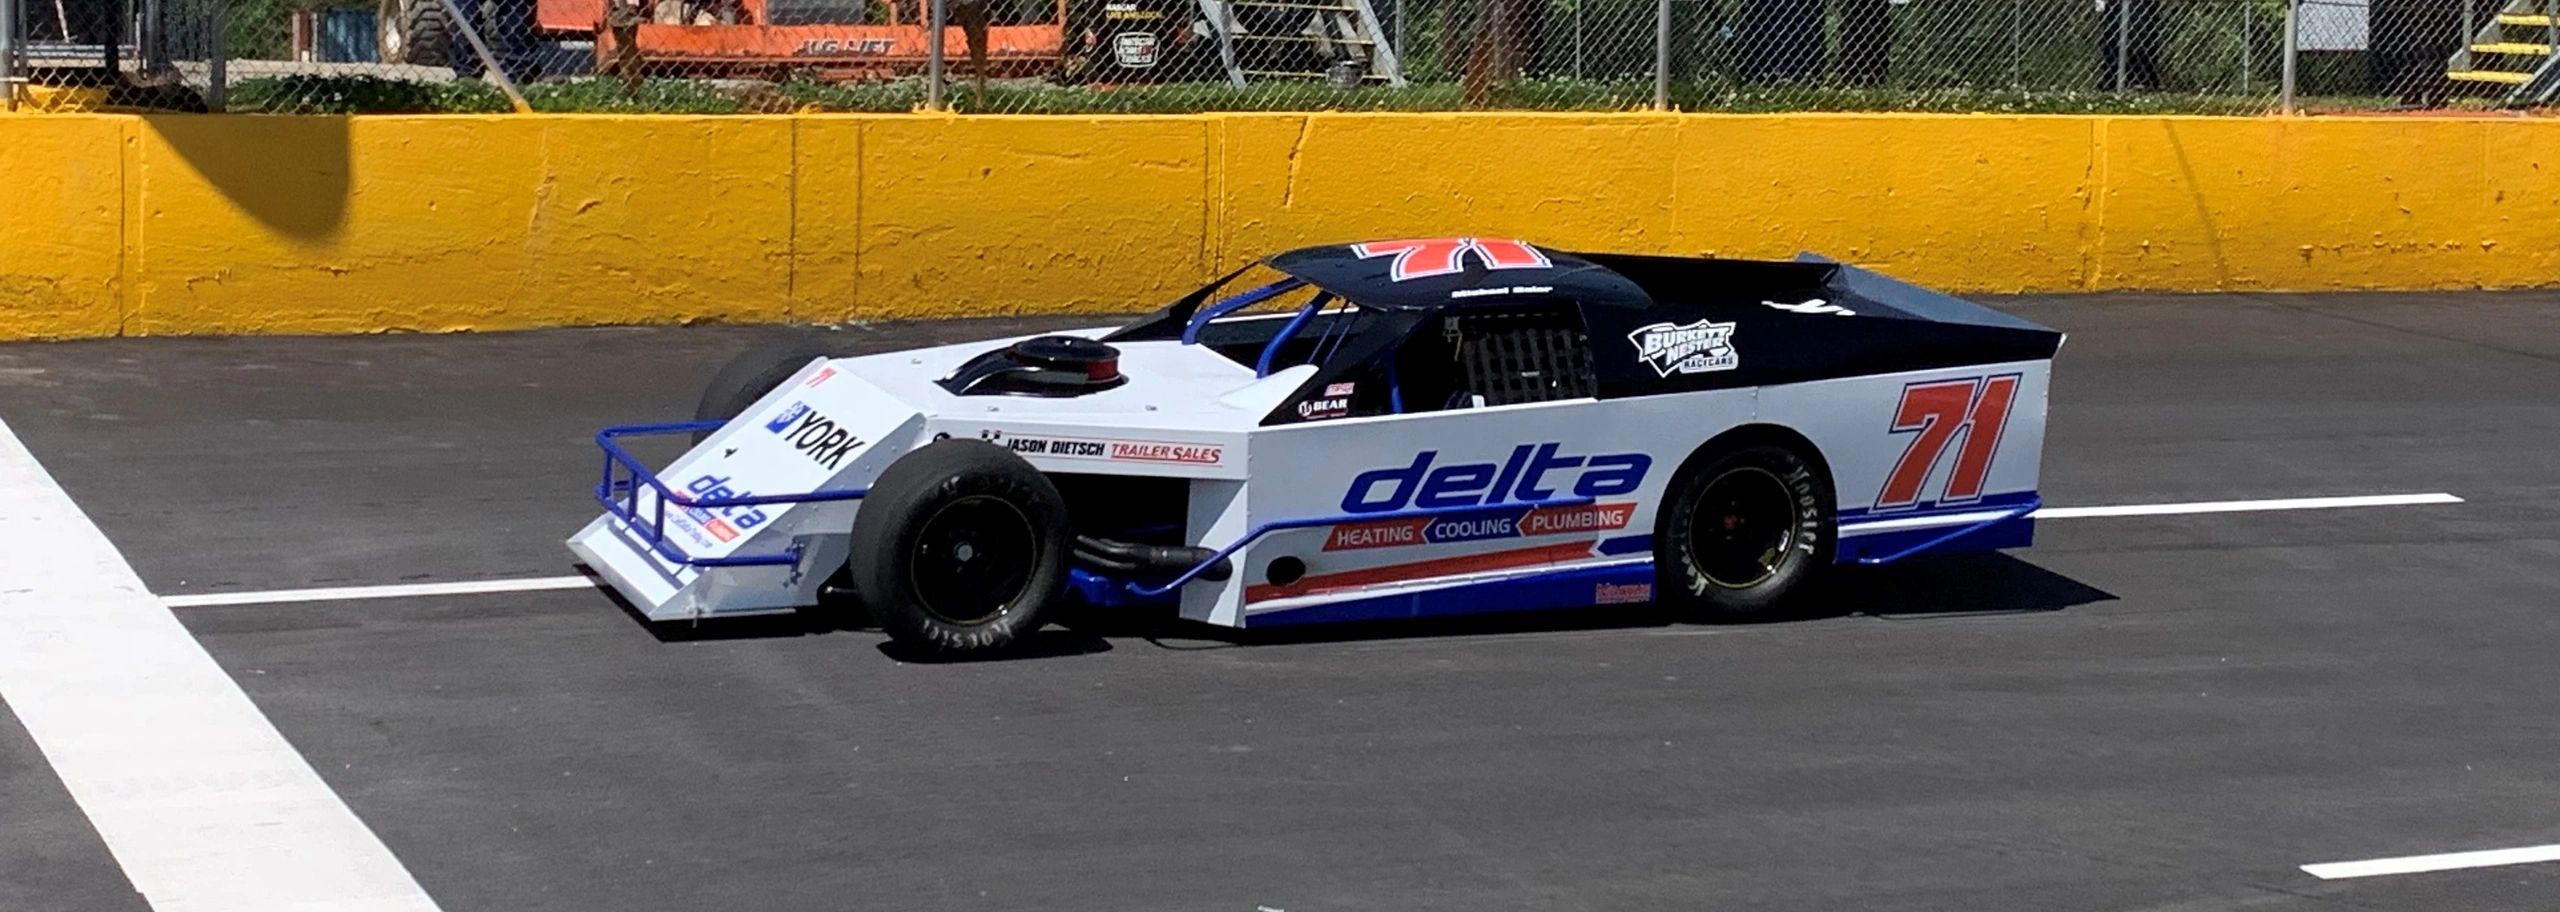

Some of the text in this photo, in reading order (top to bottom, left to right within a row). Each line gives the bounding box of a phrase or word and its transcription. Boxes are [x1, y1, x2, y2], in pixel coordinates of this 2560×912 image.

[1350, 237, 1554, 282] 71
[1644, 326, 1731, 356] BURKETT
[1665, 337, 1725, 366] NESTER
[1313, 399, 1348, 412] BEAR
[784, 410, 865, 471] YORK
[1007, 438, 1222, 464] JASON DIETSCH TRAILER SALES
[1868, 372, 2023, 514] 71
[1341, 442, 1653, 514] delta
[1337, 509, 1624, 546] HEATING COOLING PLUMBING
